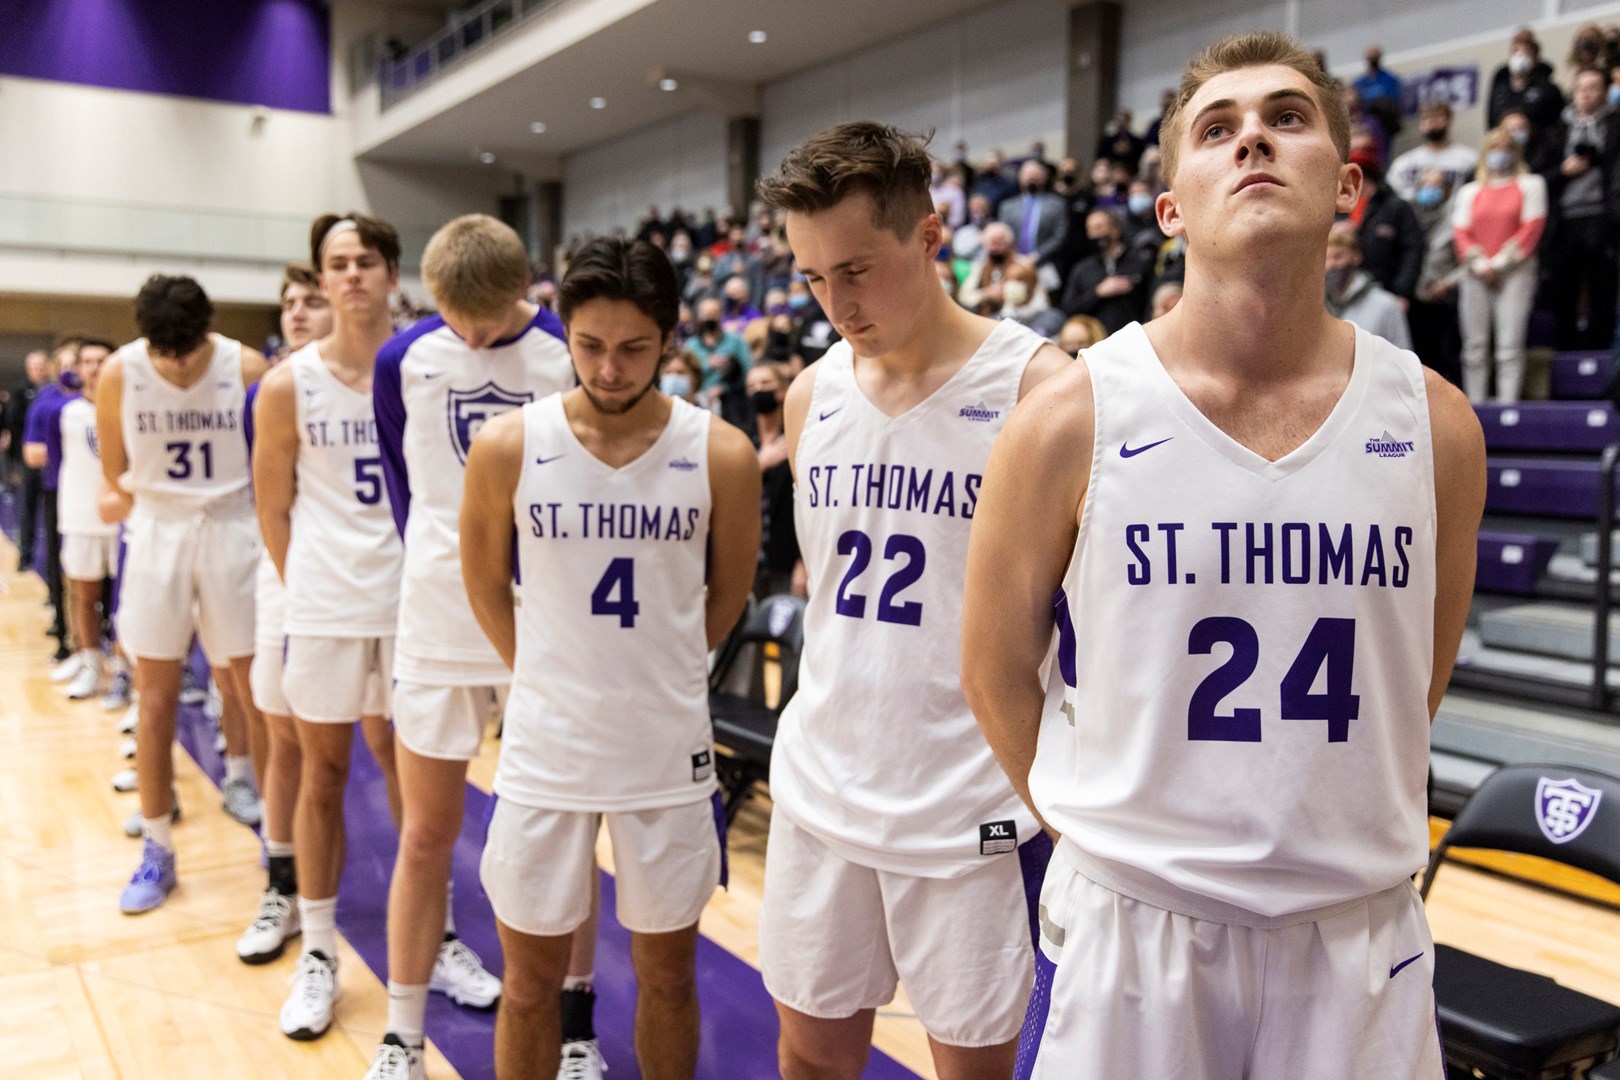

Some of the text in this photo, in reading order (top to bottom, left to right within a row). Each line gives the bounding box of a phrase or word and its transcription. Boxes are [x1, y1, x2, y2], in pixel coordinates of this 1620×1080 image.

[166, 409, 237, 433] THOMAS
[959, 408, 1000, 418] SUMMIT
[307, 422, 335, 447] ST.
[1365, 441, 1415, 453] SUMMIT
[166, 441, 212, 479] 31
[355, 458, 381, 505] 5
[809, 463, 983, 520] ST. THOMAS
[529, 503, 700, 541] ST. THOMAS
[1125, 522, 1413, 588] ST. THOMAS
[591, 557, 639, 628] 4
[835, 529, 926, 626] 22
[1187, 616, 1360, 743] 24
[989, 824, 1010, 837] XL
